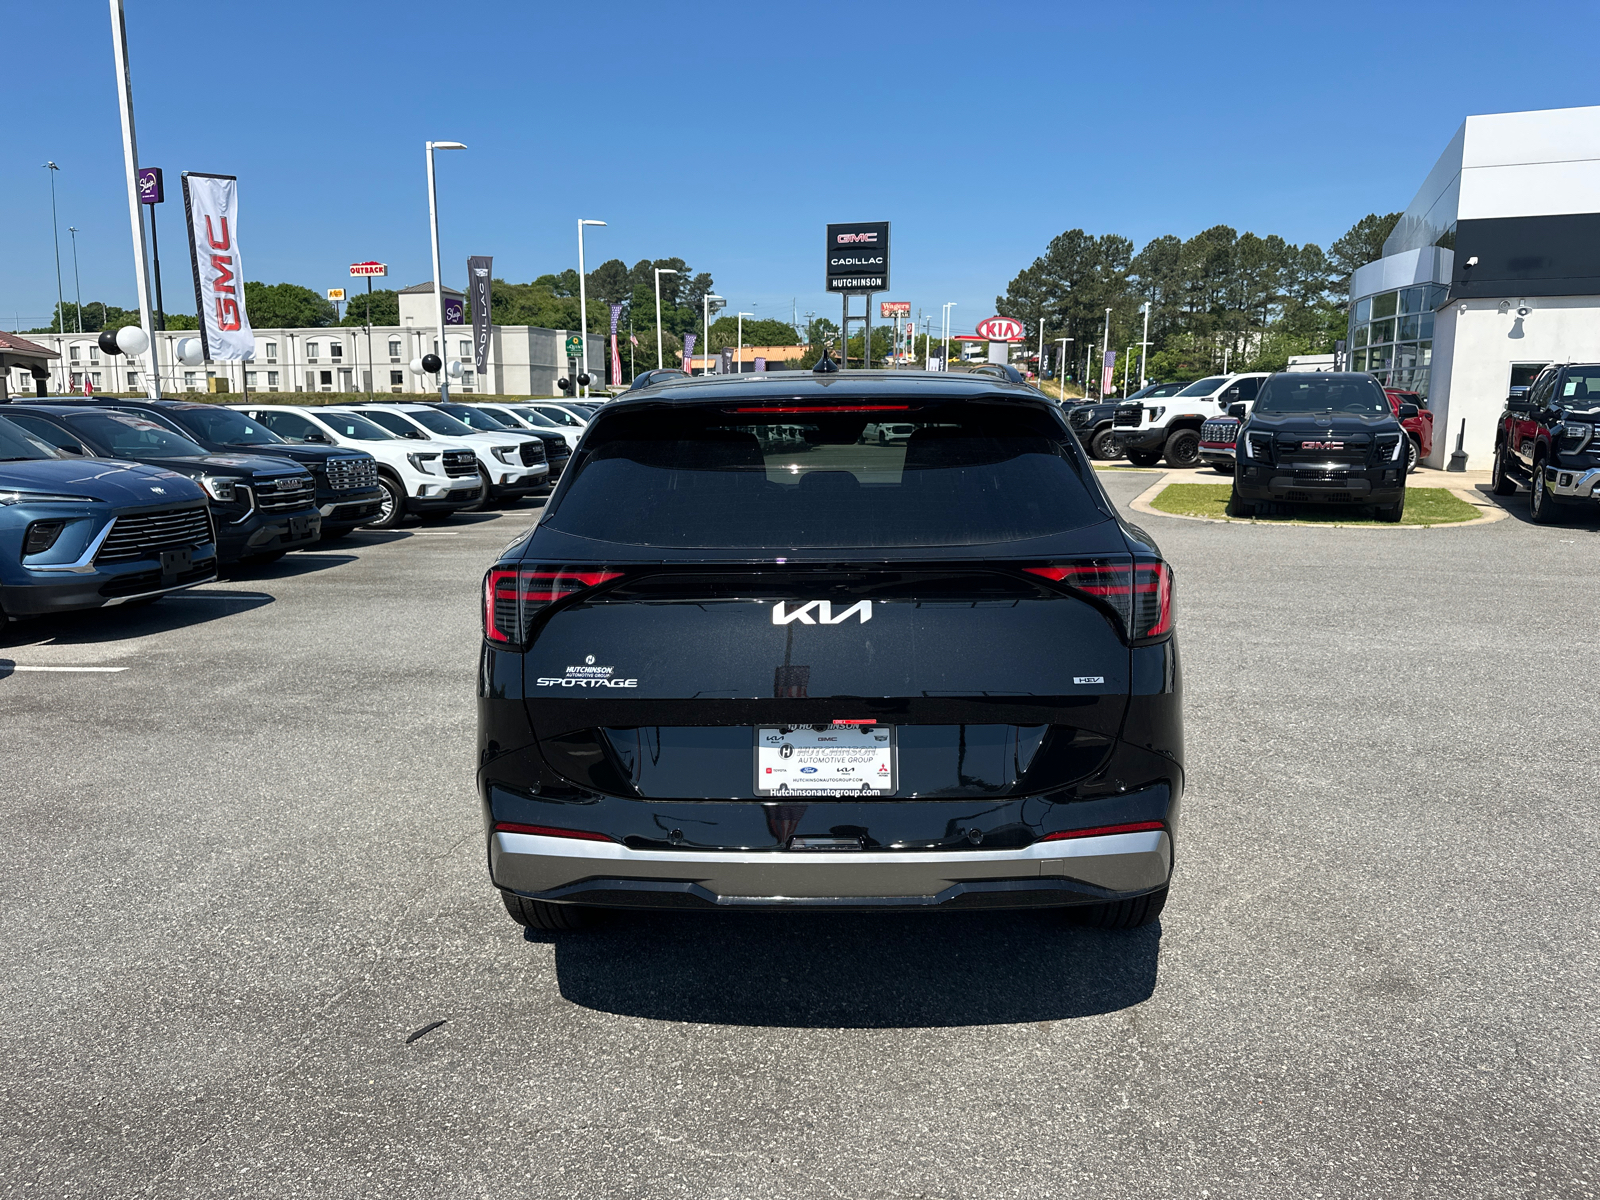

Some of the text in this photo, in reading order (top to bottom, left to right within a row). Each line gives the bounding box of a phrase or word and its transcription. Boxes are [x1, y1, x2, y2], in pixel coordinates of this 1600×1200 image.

[837, 232, 878, 243] GMC
[831, 257, 883, 265] CADILLAC
[205, 214, 241, 331] GMC
[350, 266, 384, 274] OUTBACK
[832, 277, 882, 287] HUTCHINSON
[476, 282, 488, 367] CADILLAC
[986, 322, 1014, 337] KIA
[1301, 441, 1344, 450] GMC
[772, 600, 872, 625] KIA
[536, 678, 638, 688] SPORTAGE
[796, 746, 877, 756] HUTCHINSON
[770, 788, 881, 798] Hutchinsonautogroup.com
